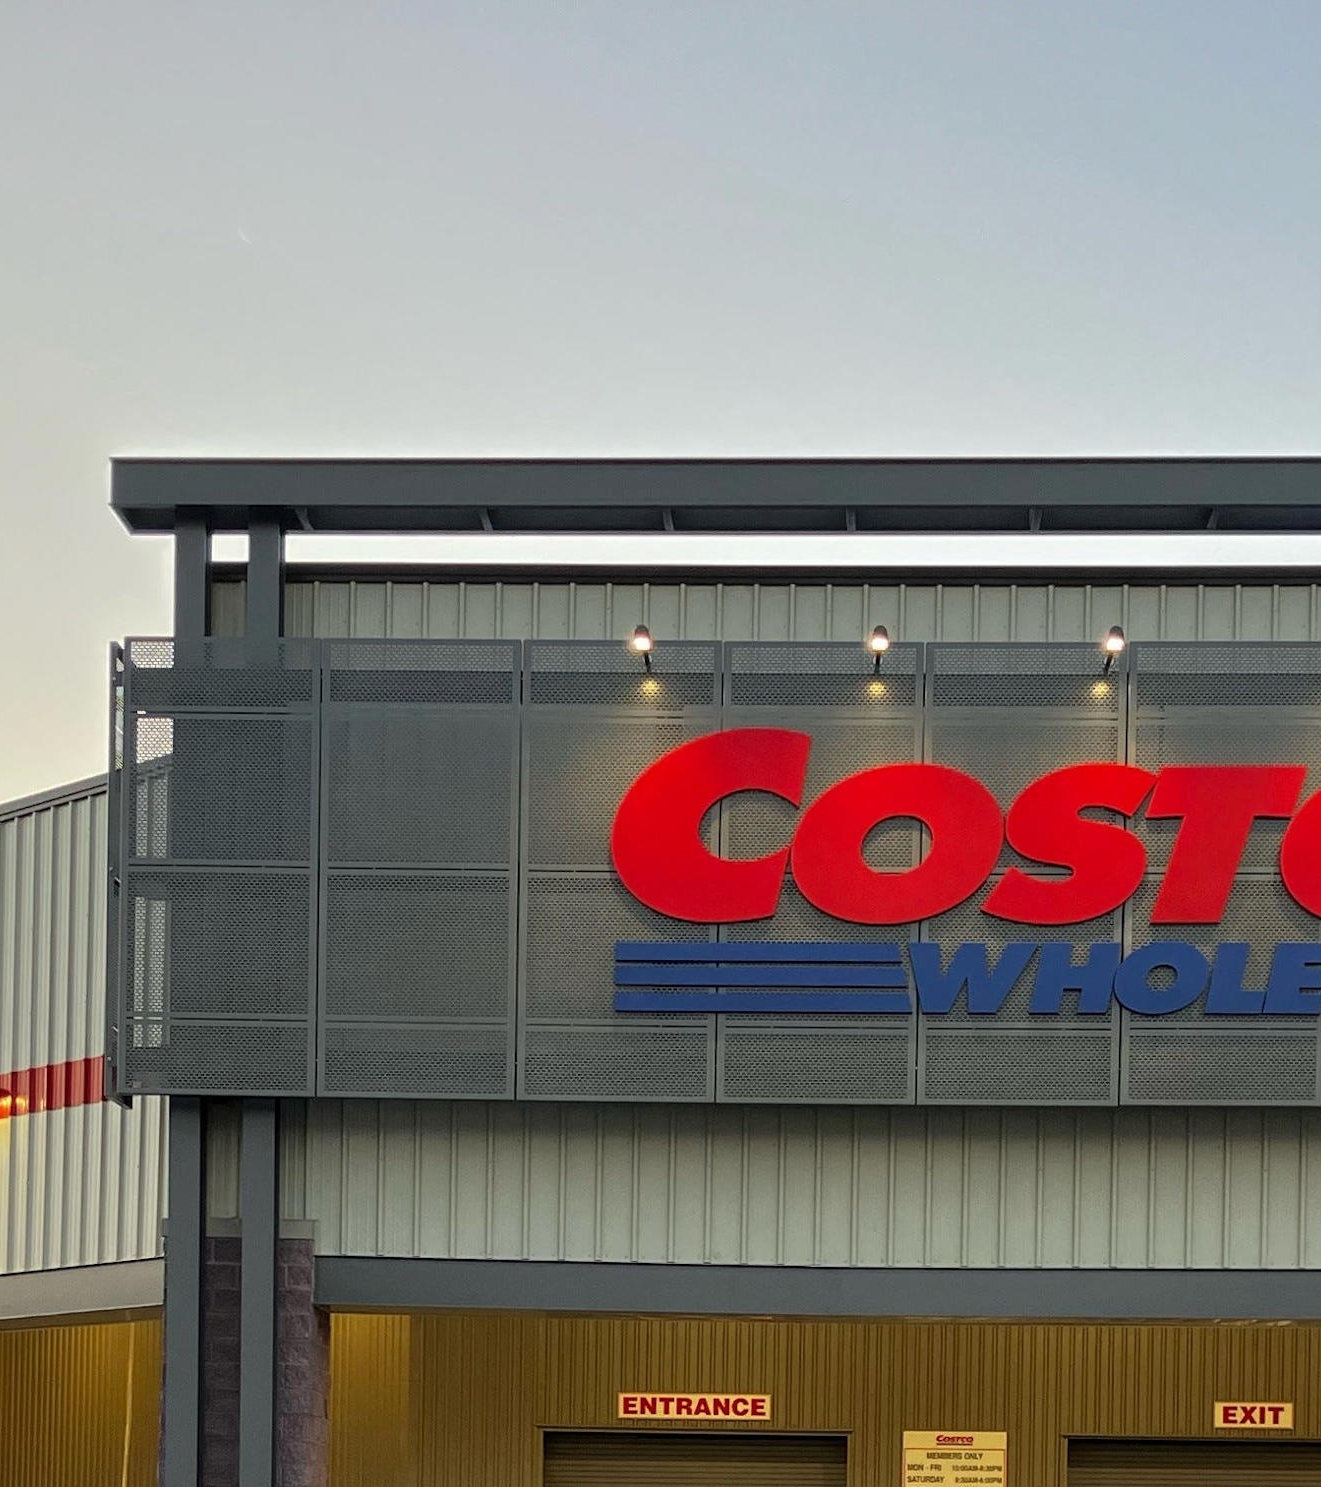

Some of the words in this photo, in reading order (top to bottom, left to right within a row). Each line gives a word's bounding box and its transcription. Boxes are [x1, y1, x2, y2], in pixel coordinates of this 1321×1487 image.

[622, 1397, 767, 1416] ENTRANCE
[1222, 1406, 1285, 1424] EXIT
[936, 1434, 974, 1443] COSTCO
[926, 1452, 963, 1460] MEMBERS
[964, 1452, 984, 1460] ONLY
